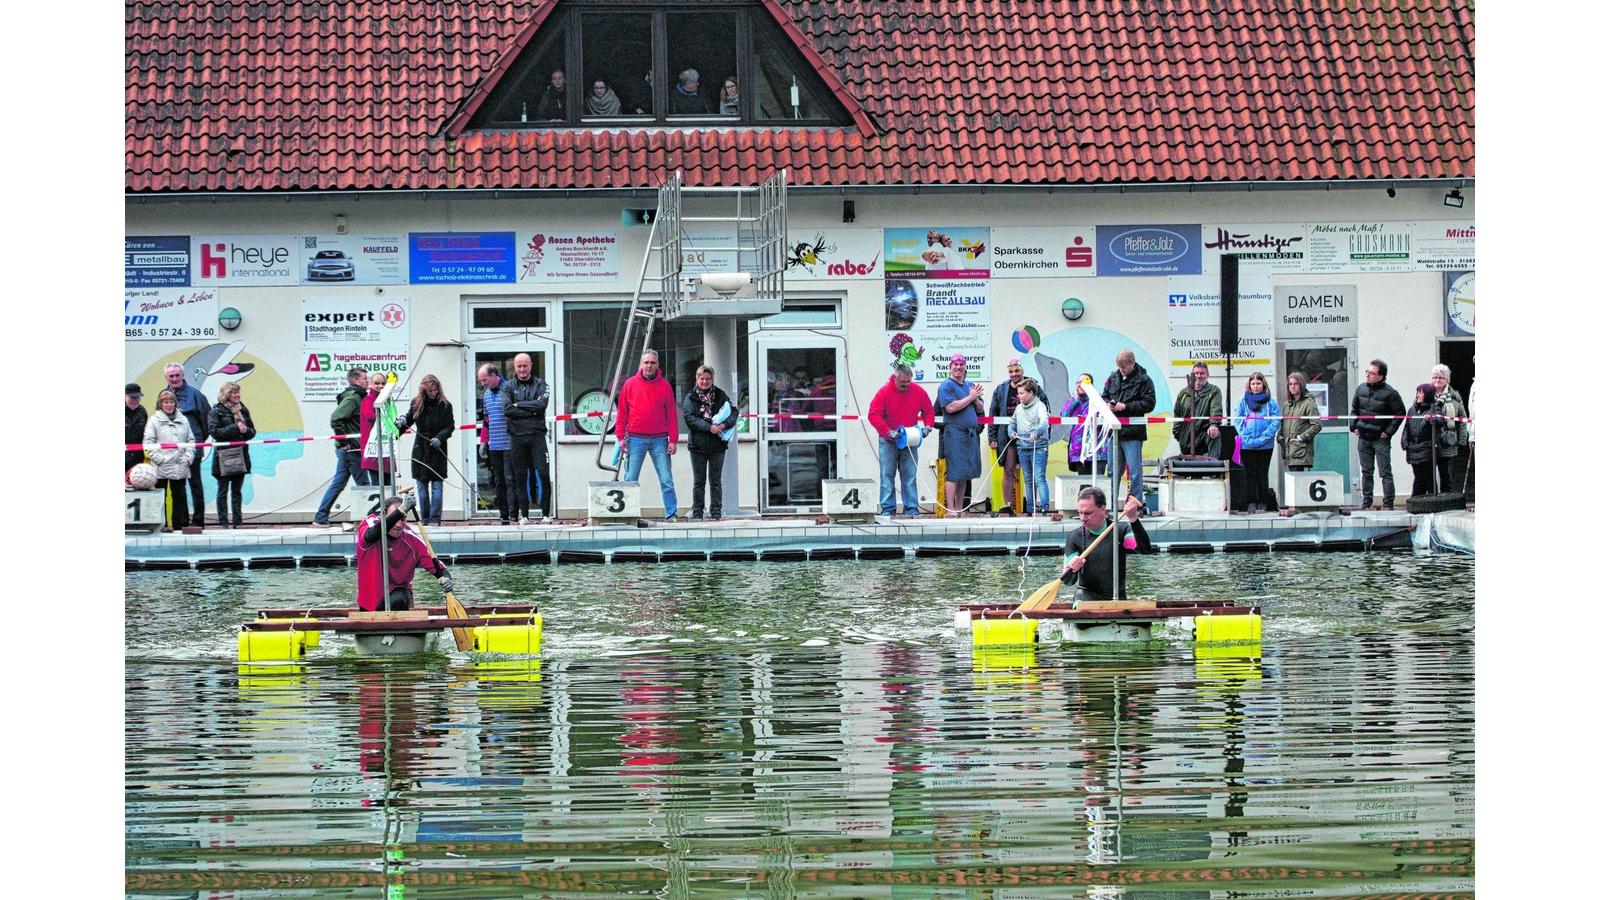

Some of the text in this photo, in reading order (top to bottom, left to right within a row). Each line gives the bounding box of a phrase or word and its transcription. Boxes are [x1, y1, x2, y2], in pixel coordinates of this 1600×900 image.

[1312, 225, 1337, 234] Möbel
[1339, 224, 1356, 232] nach
[548, 236, 616, 246] Rosen Apotheke
[231, 243, 289, 267] heye
[994, 246, 1044, 256] Sparkasse
[137, 256, 185, 264] metallbau
[994, 260, 1059, 269] Obernkirchen
[232, 268, 290, 277] international
[828, 260, 867, 275] rabe
[926, 289, 957, 297] Brandt
[140, 301, 174, 313] Wohnen
[177, 295, 185, 305] &
[926, 296, 986, 306] METALLBAU
[1288, 295, 1344, 309] DAMEN
[305, 311, 375, 324] expert
[1283, 315, 1350, 323] Garderobe Toiletten
[172, 328, 182, 336] 24
[191, 328, 200, 336] 39
[204, 328, 214, 336] 60
[1171, 338, 1220, 347] SCHAUMBUR
[334, 353, 407, 362] hagebaucentrum
[1309, 480, 1327, 502] 6
[606, 490, 625, 513] 3
[842, 488, 861, 509] 4
[127, 498, 141, 521] 1
[367, 494, 382, 516] 2
